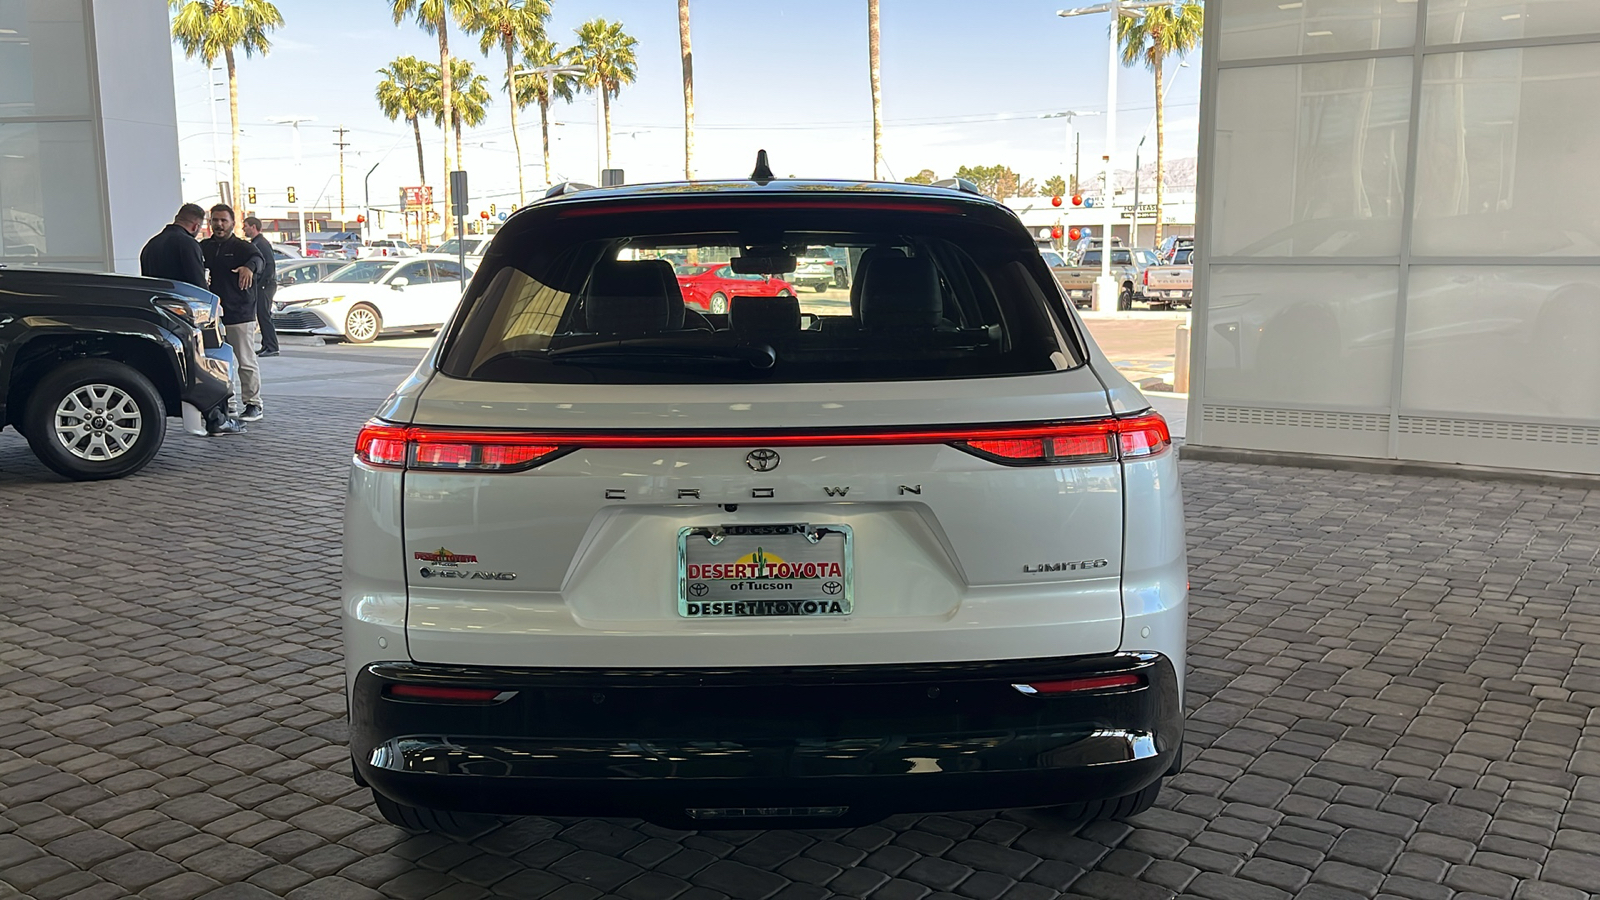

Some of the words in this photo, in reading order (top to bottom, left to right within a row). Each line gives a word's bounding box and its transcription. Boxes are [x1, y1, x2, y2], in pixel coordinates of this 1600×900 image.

[605, 484, 922, 500] CROWN
[725, 524, 806, 535] TUCSON
[687, 563, 760, 579] DESERT
[764, 562, 843, 578] TOYOTA
[1023, 558, 1108, 573] LIMITED
[470, 570, 518, 581] AWD
[730, 581, 745, 591] of
[746, 581, 793, 591] Tucson
[687, 601, 757, 616] DESERT
[763, 600, 843, 615] TOYOTA
